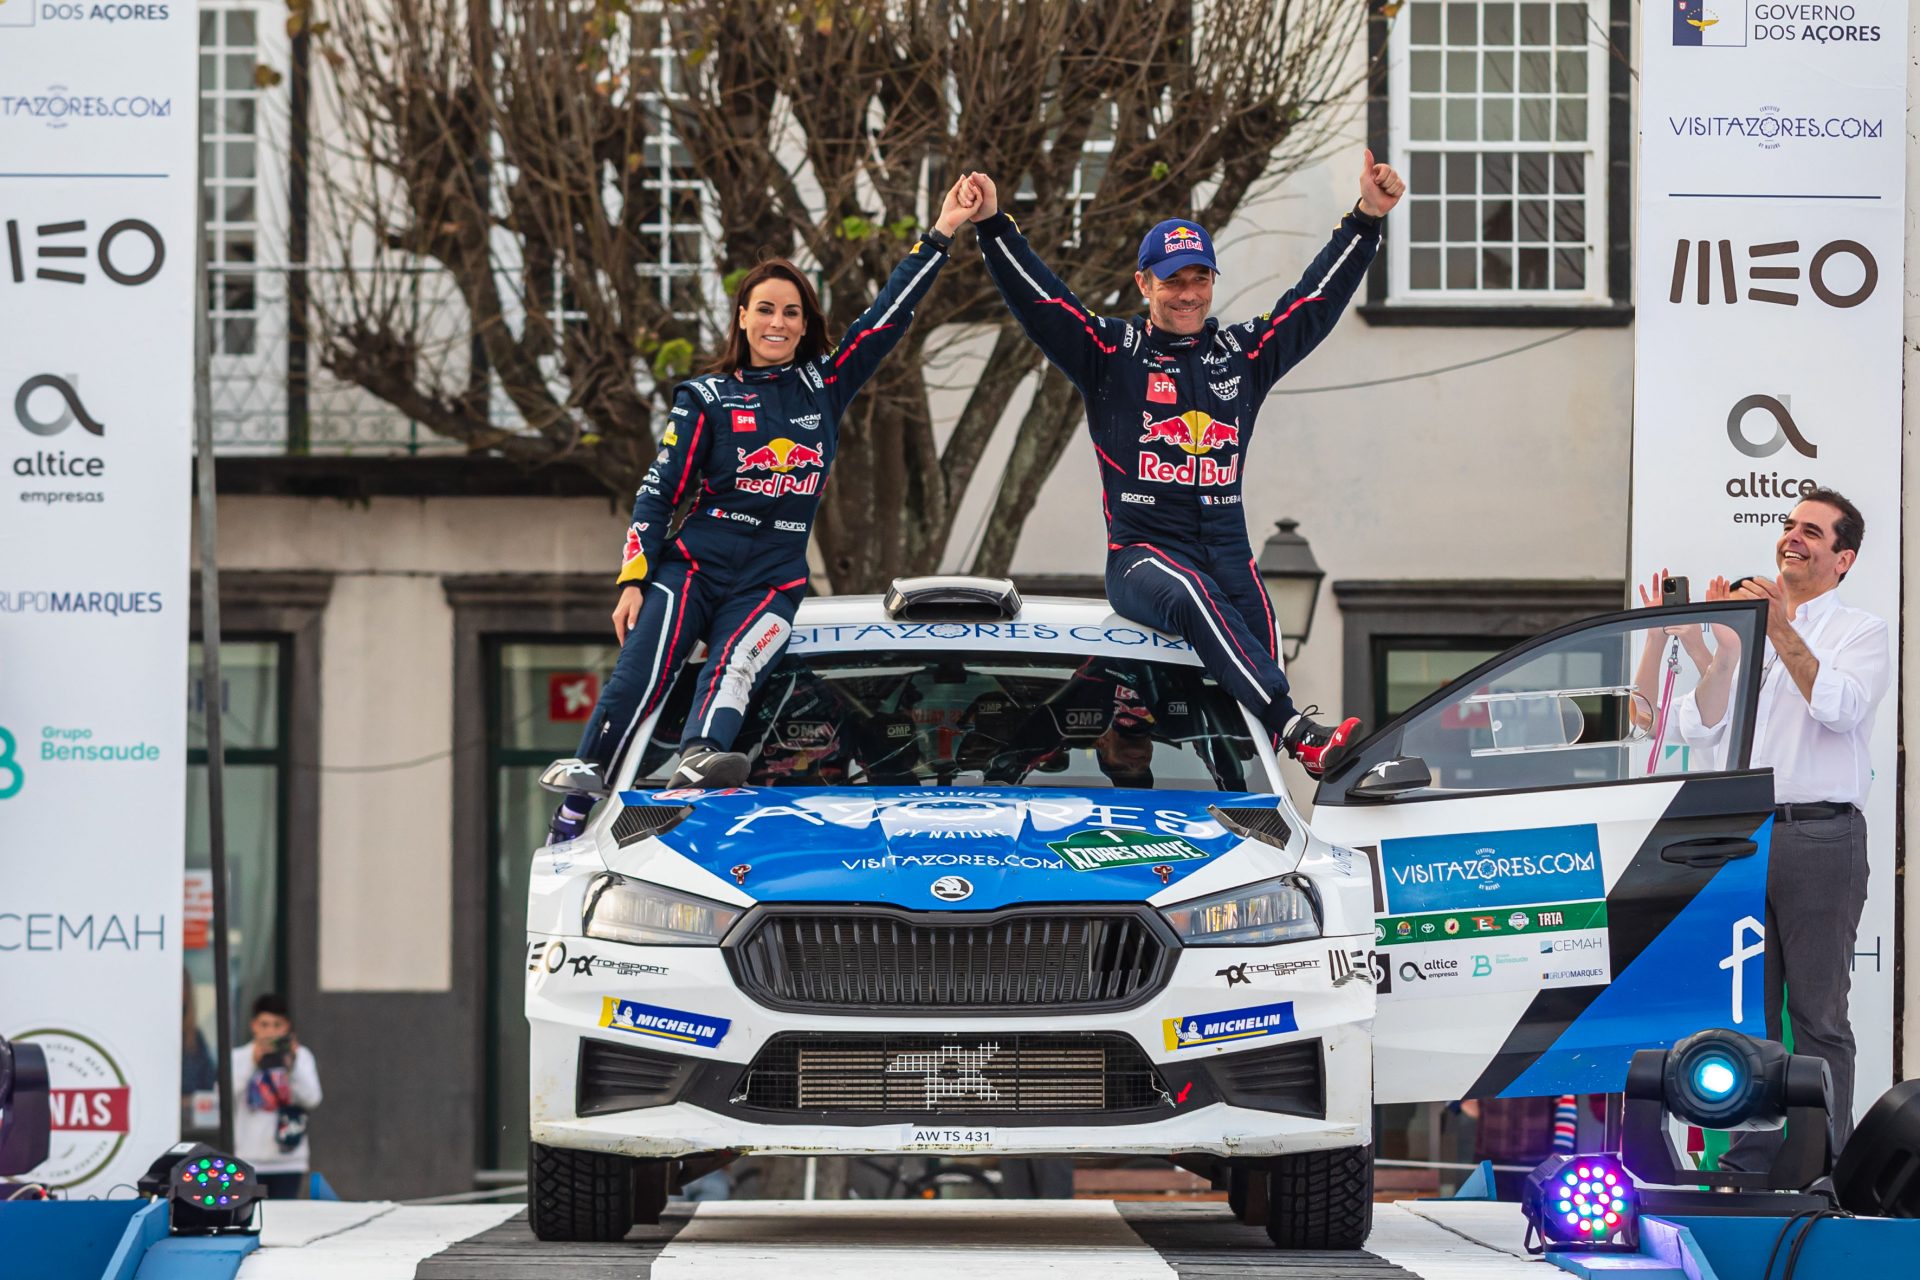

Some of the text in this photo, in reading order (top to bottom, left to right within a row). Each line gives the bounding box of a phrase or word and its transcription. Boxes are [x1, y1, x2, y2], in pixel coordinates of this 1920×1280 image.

[41, 4, 169, 22] DOS AÇORES
[1755, 4, 1856, 21] GOVERNO
[1754, 24, 1881, 44] DOS AÇORES
[1669, 116, 1883, 138] VISITAZORES.COM
[1669, 238, 1879, 309] MEO
[1153, 381, 1176, 393] SFR
[737, 415, 756, 425] SFR
[13, 451, 105, 477] altice
[1138, 451, 1239, 486] Red Bull
[735, 472, 821, 498] Red Bull
[1726, 471, 1818, 498] altice
[20, 490, 105, 504] empresas
[1121, 493, 1155, 504] sparco
[731, 512, 761, 526] GODEY
[774, 519, 806, 531] sparco
[1733, 512, 1788, 527] empre
[0, 591, 163, 616] RUPOMARQUES
[1066, 712, 1103, 726] OMP
[42, 726, 92, 741] Grupo
[886, 726, 911, 736] OMP
[41, 742, 160, 761] Bensaude
[725, 798, 1214, 839] AZORES
[929, 828, 1010, 839] NATURE
[1100, 830, 1124, 842] 1
[842, 854, 1064, 870] VISITAZORES.COM
[1063, 841, 1202, 869] AZORES RALLYE
[1392, 851, 1596, 885] VISITAZORES.COM
[1538, 911, 1563, 926] TRTA
[1554, 938, 1602, 952] CEMAH
[1424, 959, 1457, 971] altice
[1428, 971, 1459, 979] empresas
[636, 1013, 717, 1038] MICHELIN
[1204, 1013, 1281, 1036] MICHELIN
[915, 1131, 990, 1142] AW TS 431
